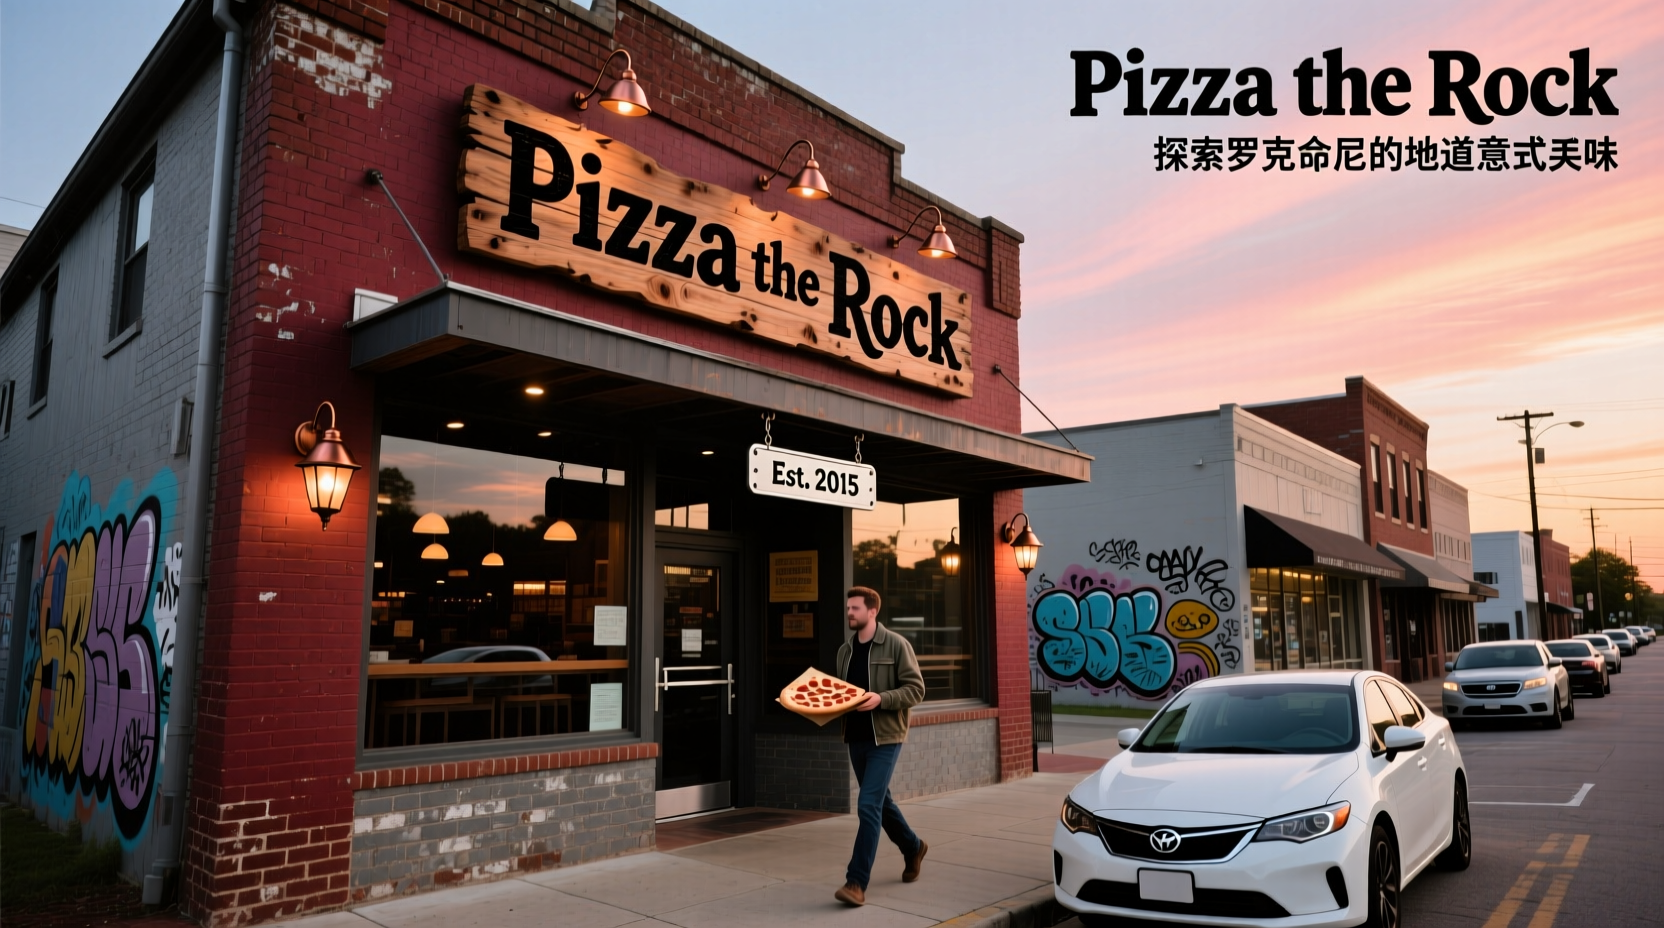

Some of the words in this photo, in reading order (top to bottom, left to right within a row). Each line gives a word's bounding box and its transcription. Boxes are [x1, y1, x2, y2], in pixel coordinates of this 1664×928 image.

[500, 119, 741, 293] Pizza
[751, 240, 820, 307] the
[827, 251, 962, 371] Rock
[772, 460, 810, 490] Est.
[815, 468, 859, 497] 2015
